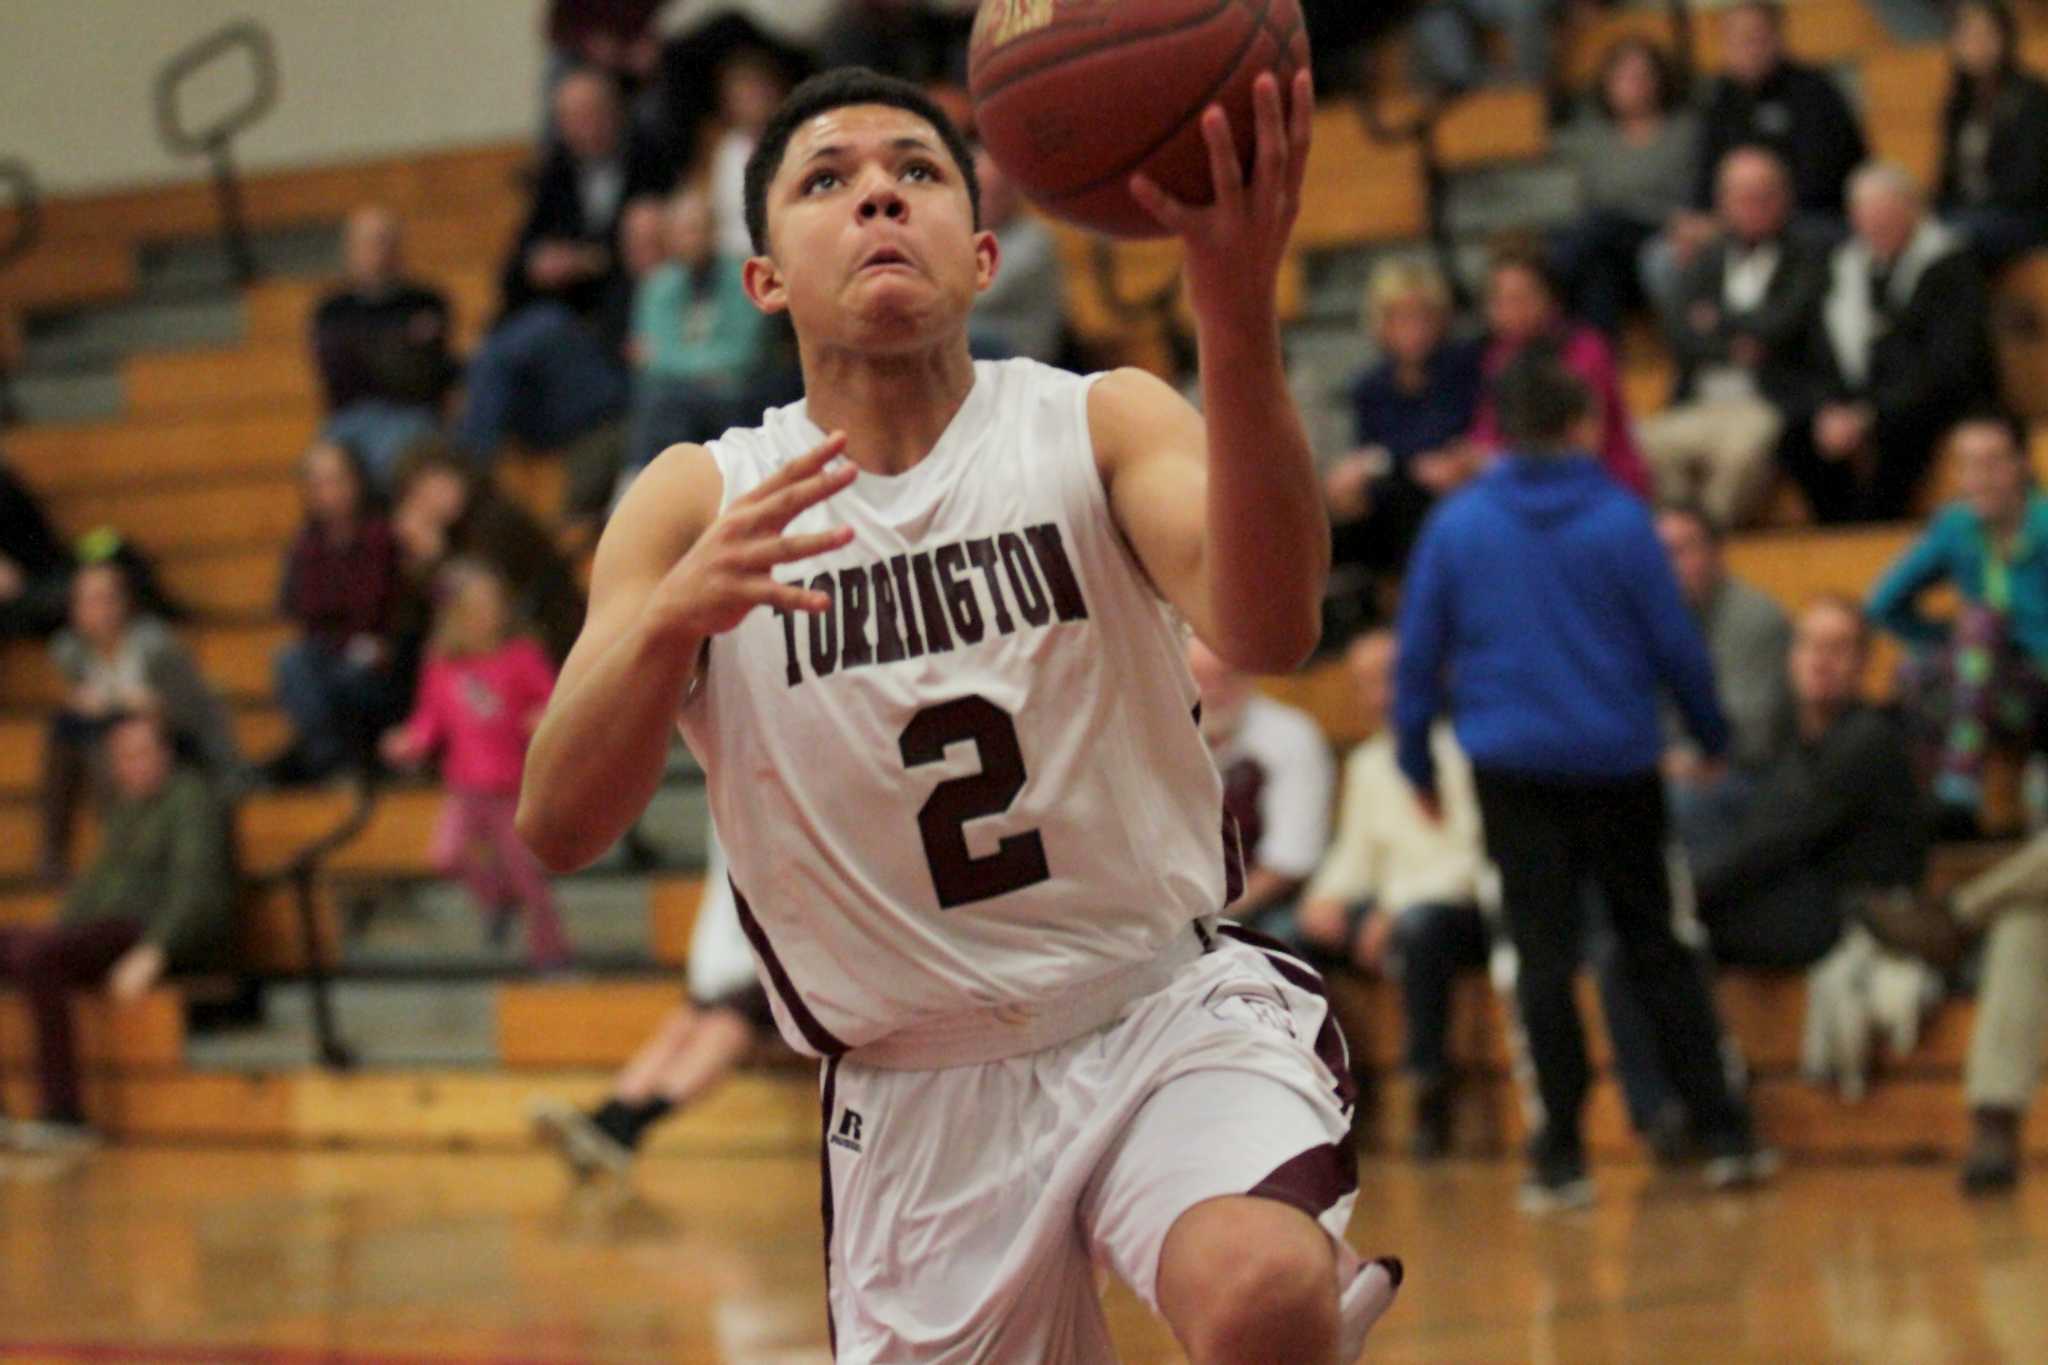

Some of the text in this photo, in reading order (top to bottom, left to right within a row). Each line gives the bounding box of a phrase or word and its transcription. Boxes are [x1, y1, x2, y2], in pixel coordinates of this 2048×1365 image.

[773, 523, 1088, 687] TORRINGTON
[898, 694, 1051, 909] 2
[839, 1108, 862, 1140] R
